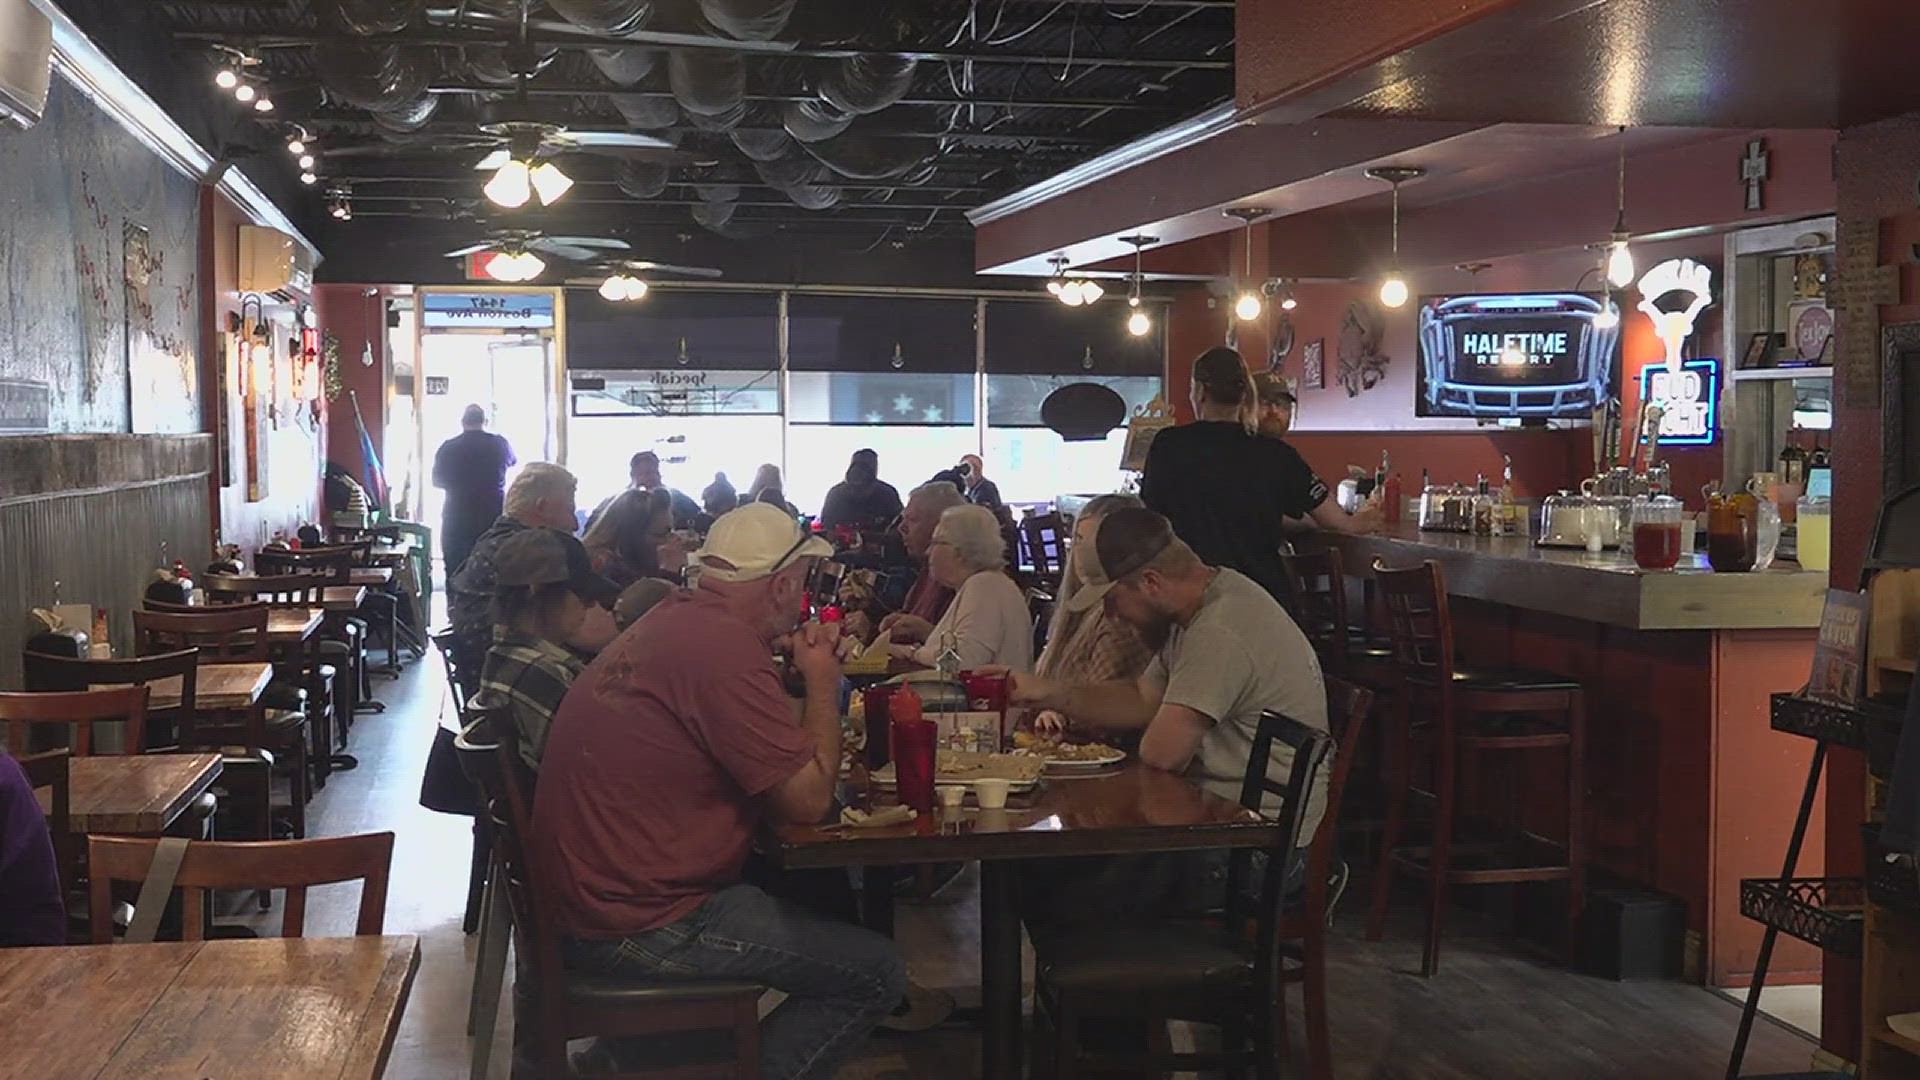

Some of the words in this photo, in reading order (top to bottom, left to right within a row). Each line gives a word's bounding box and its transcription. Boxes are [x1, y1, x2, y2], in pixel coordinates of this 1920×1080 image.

[1463, 333, 1567, 353] HALFTIME
[1477, 354, 1554, 365] RERT
[1643, 402, 1708, 434] GHT
